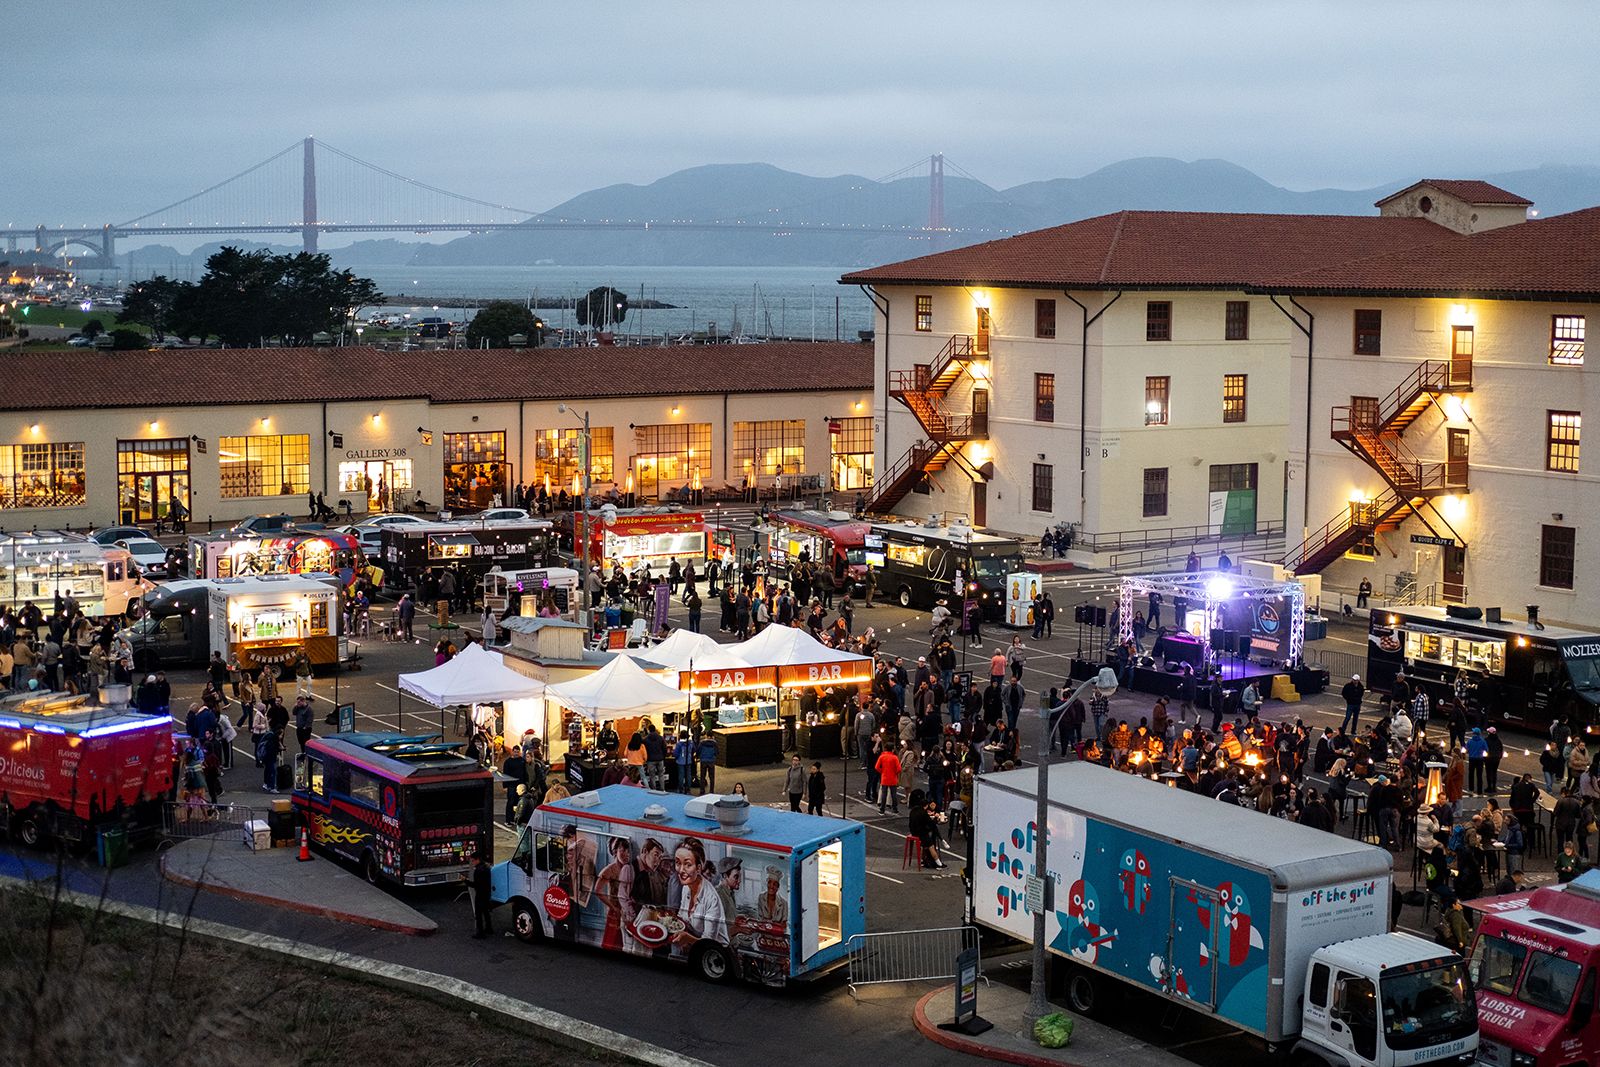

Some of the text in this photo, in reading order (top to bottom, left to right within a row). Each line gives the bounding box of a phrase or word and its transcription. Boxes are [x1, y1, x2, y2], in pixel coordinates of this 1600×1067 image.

[346, 447, 407, 460] GALLERY 308
[1085, 447, 1091, 457] B
[1102, 448, 1109, 458] B
[1288, 469, 1296, 480] C
[474, 543, 526, 556] BACON BACON
[711, 671, 746, 688] BAR
[808, 664, 842, 681] BAR
[58, 749, 81, 759] FLAVORS
[62, 759, 78, 768] FROM
[1011, 820, 1051, 854] of
[986, 841, 1024, 880] the
[1302, 880, 1375, 907] off the grid
[1480, 996, 1527, 1019] LOBSTA
[1477, 1008, 1516, 1030] TRUCK
[1414, 1040, 1466, 1062] OFFTHEGRID.COM
